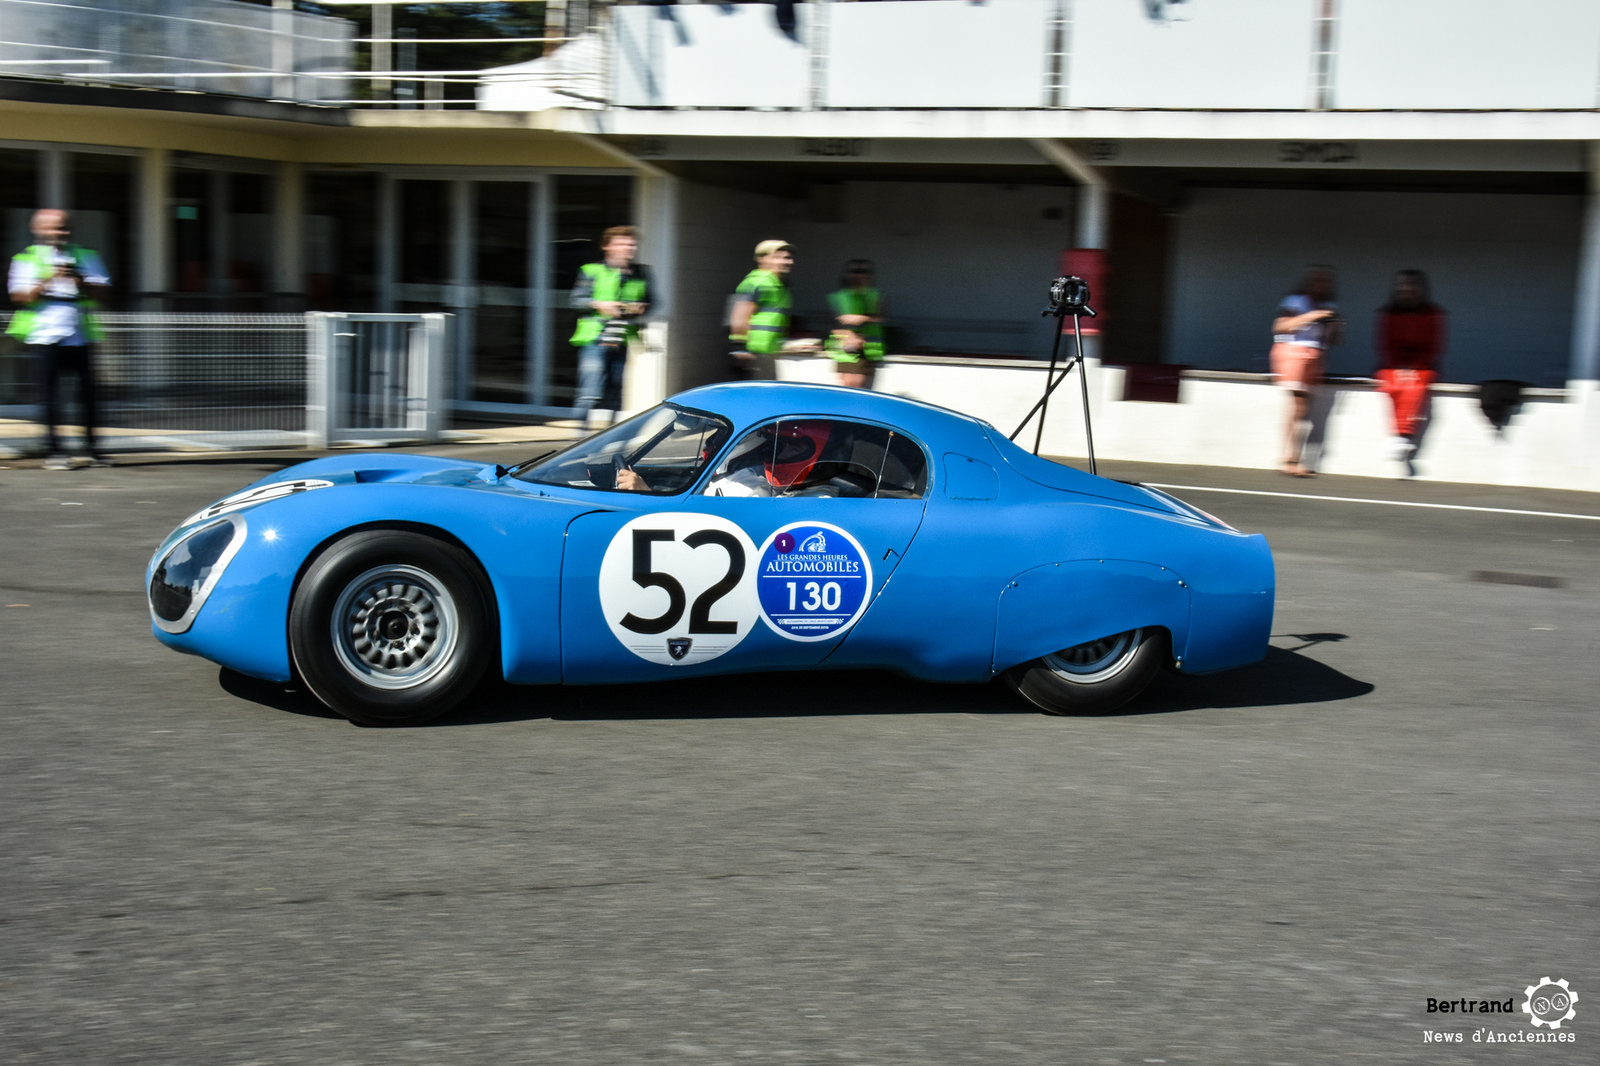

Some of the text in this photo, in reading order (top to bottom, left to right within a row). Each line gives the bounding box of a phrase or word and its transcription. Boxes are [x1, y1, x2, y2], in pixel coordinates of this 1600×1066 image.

[781, 539, 786, 547] 1
[766, 561, 859, 572] AUTOMOBILES
[619, 528, 746, 635] 52
[786, 581, 842, 611] 130
